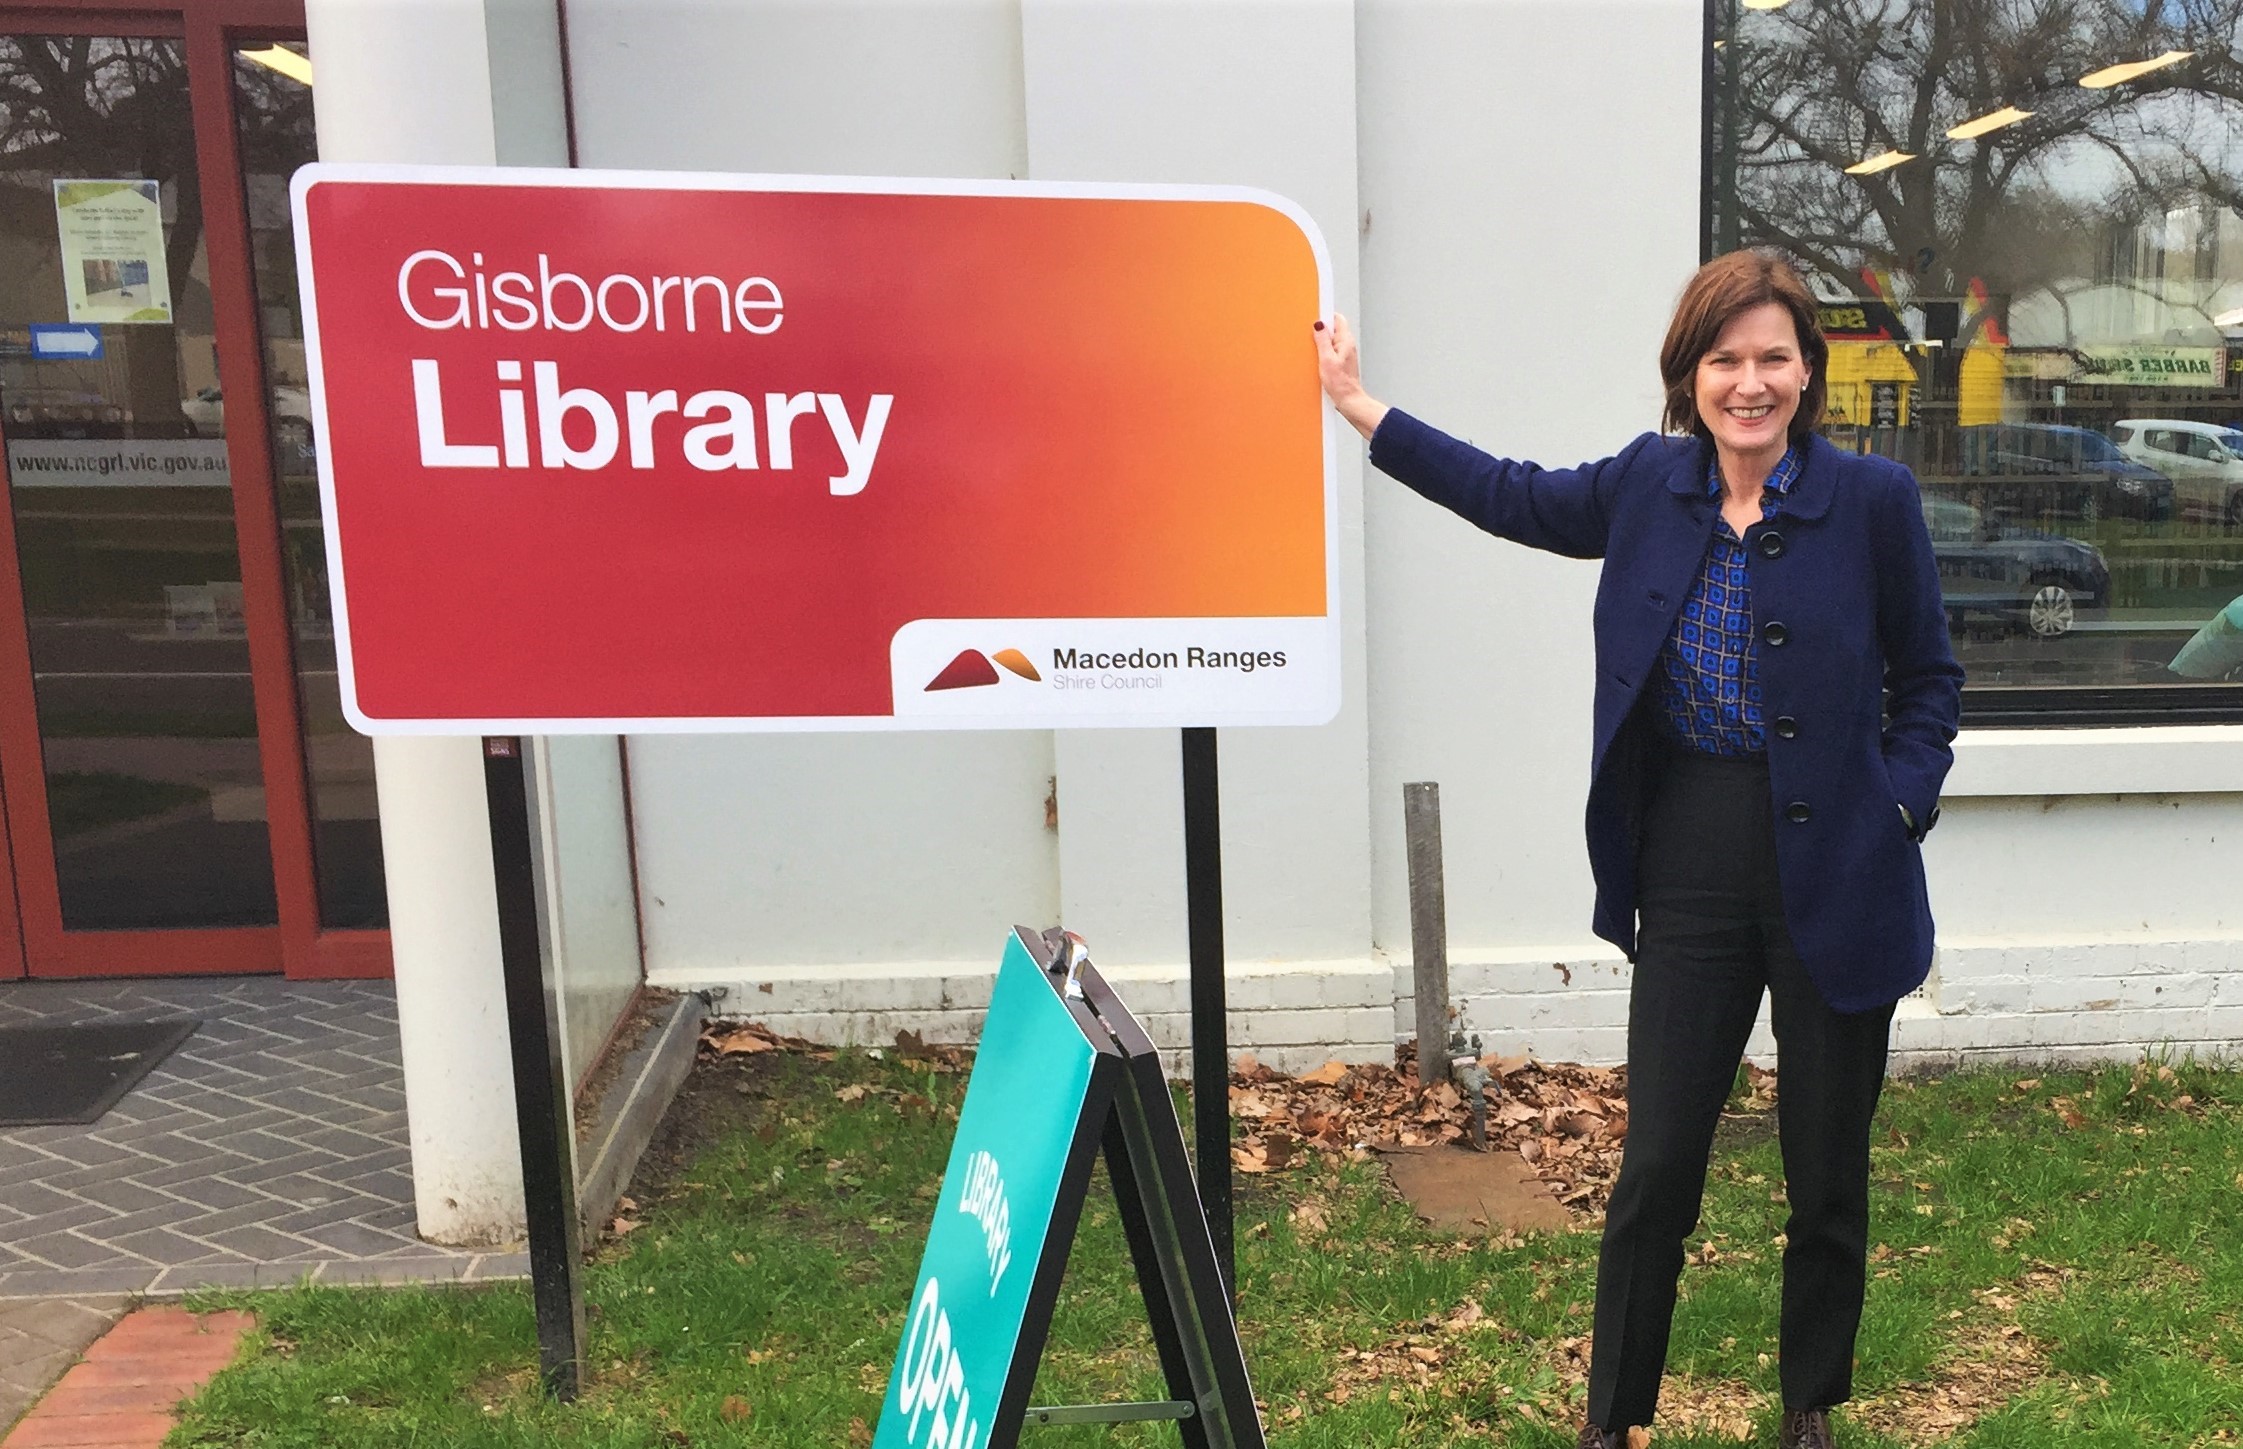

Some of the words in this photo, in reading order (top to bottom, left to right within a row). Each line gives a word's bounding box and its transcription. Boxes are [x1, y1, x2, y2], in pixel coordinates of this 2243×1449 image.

[398, 250, 785, 335] Gisborne
[411, 359, 895, 496] Library
[15, 452, 227, 475] www.ncgrl.vic.gov.au
[1053, 647, 1178, 669] Macedon
[1186, 646, 1287, 673] Ranges
[1053, 674, 1096, 690] Shire
[1101, 673, 1162, 690] Council
[958, 1150, 1011, 1297] LIBRARY
